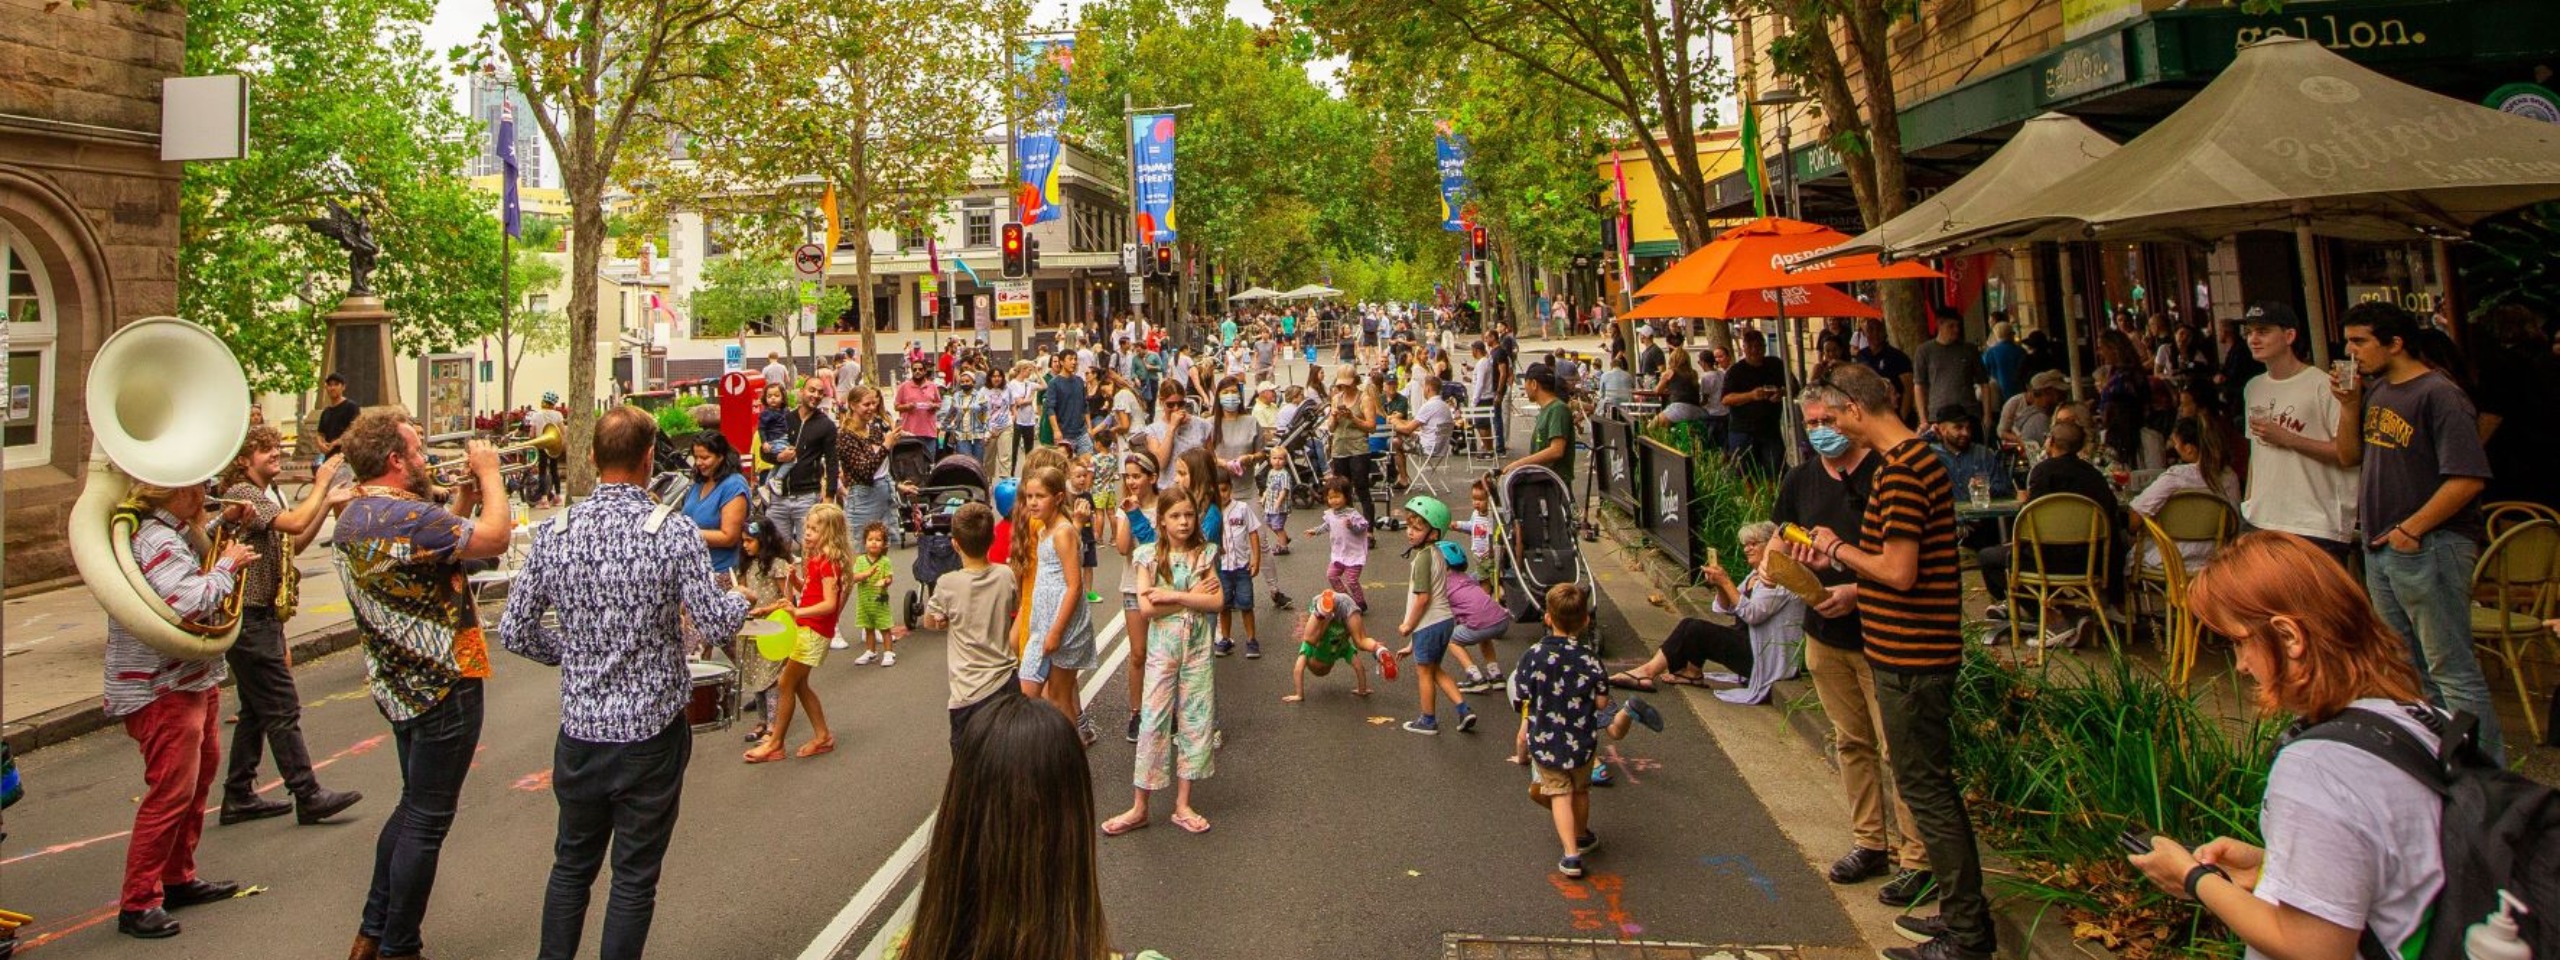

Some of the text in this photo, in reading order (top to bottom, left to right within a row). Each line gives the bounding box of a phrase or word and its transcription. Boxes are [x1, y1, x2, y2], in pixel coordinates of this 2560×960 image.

[2045, 52, 2109, 98] gallon.
[1771, 246, 1837, 271] APERO
[1782, 295, 1811, 307] PRITZ
